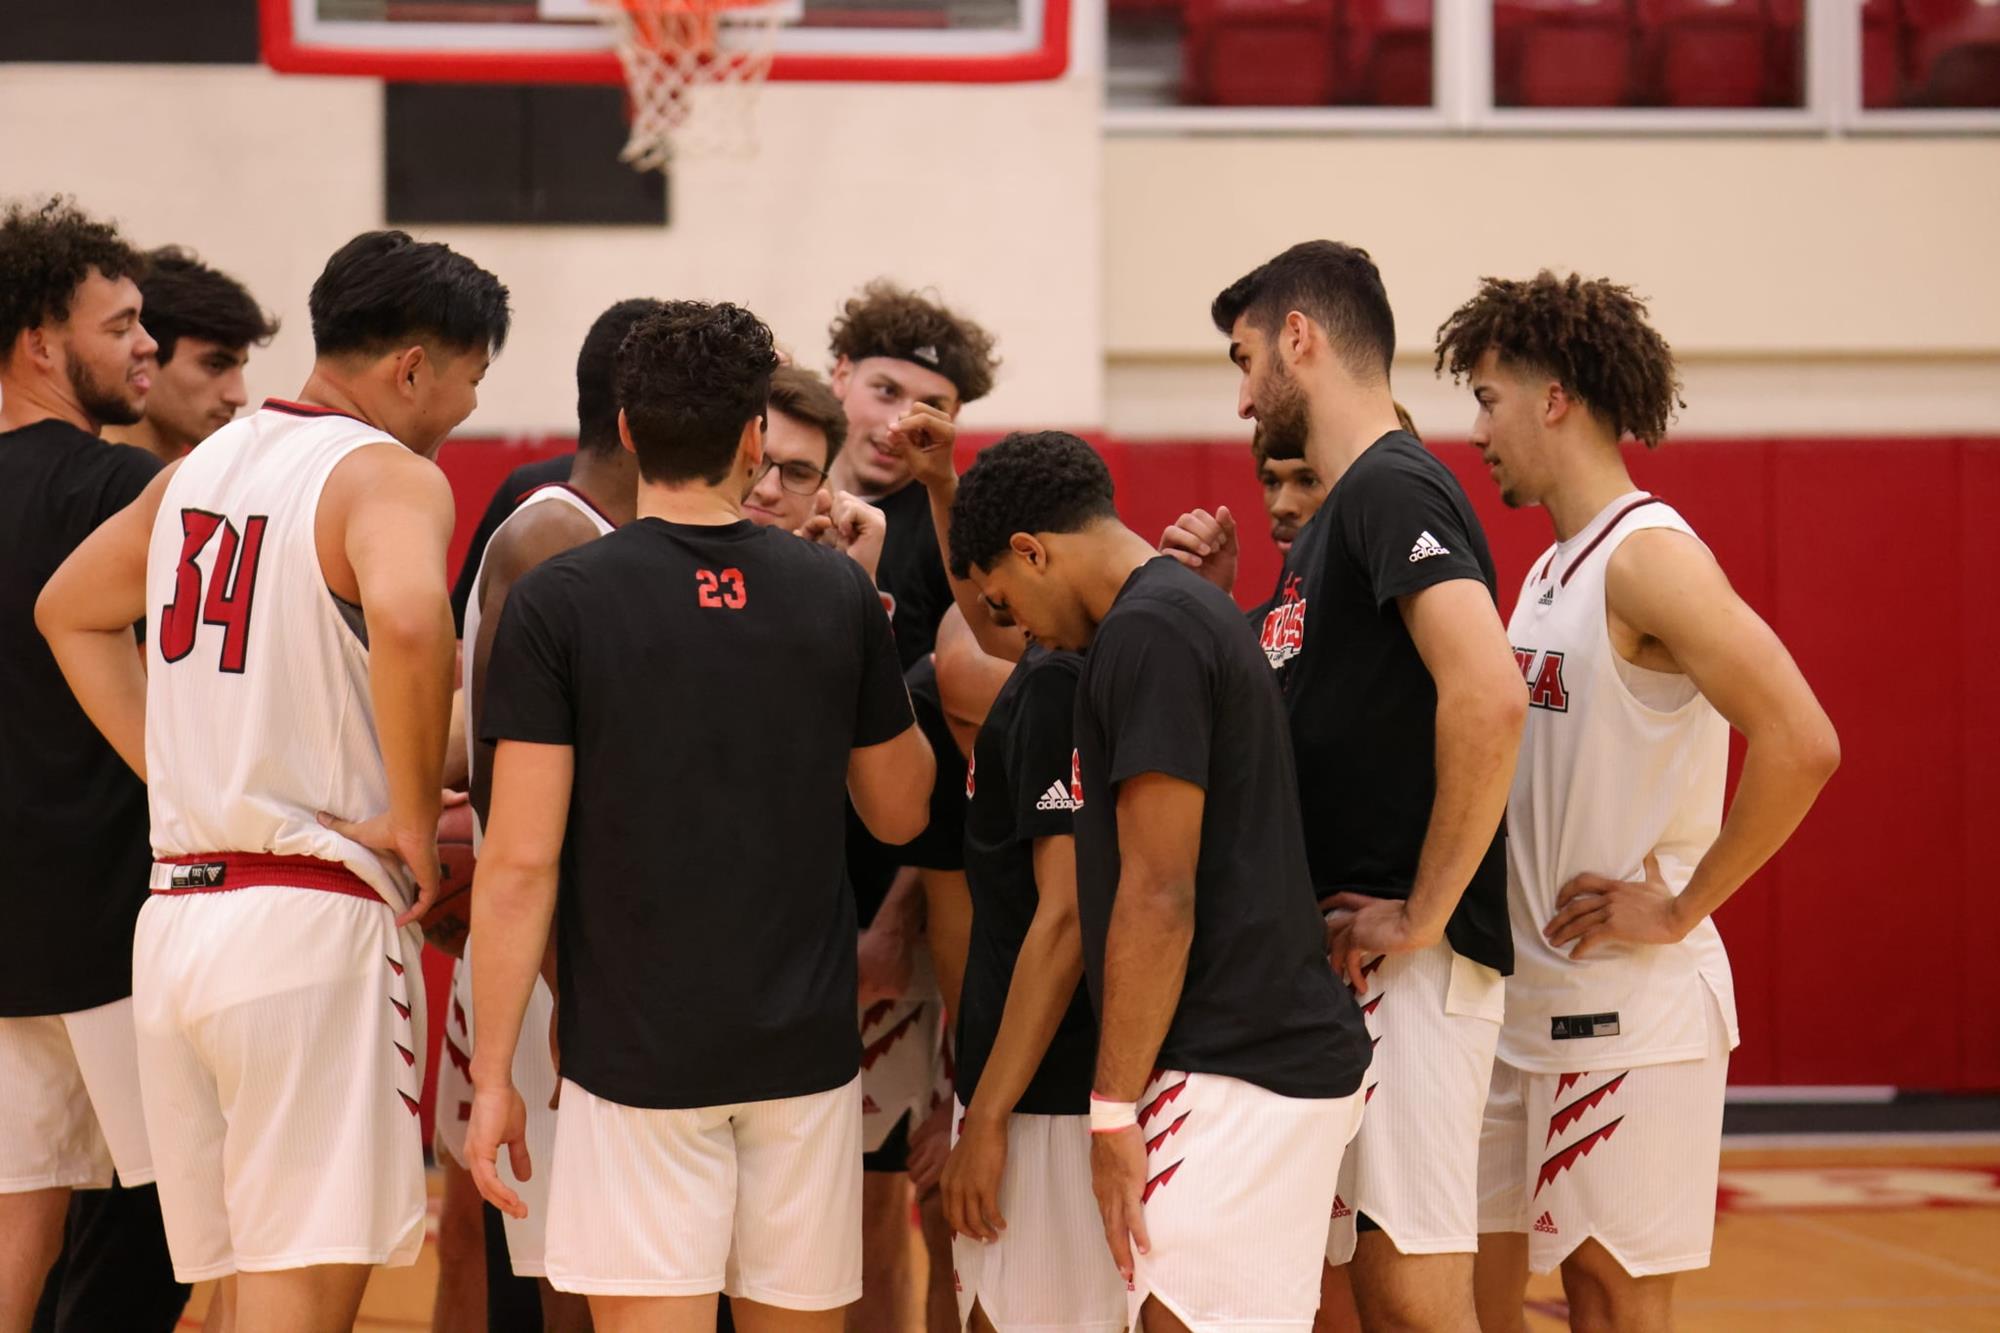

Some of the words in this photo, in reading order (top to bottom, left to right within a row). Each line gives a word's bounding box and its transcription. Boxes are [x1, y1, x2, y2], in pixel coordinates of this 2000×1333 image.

[1409, 547, 1451, 562] adidas
[160, 508, 269, 674] 34
[696, 568, 747, 609] 23
[1036, 799, 1074, 811] adidas
